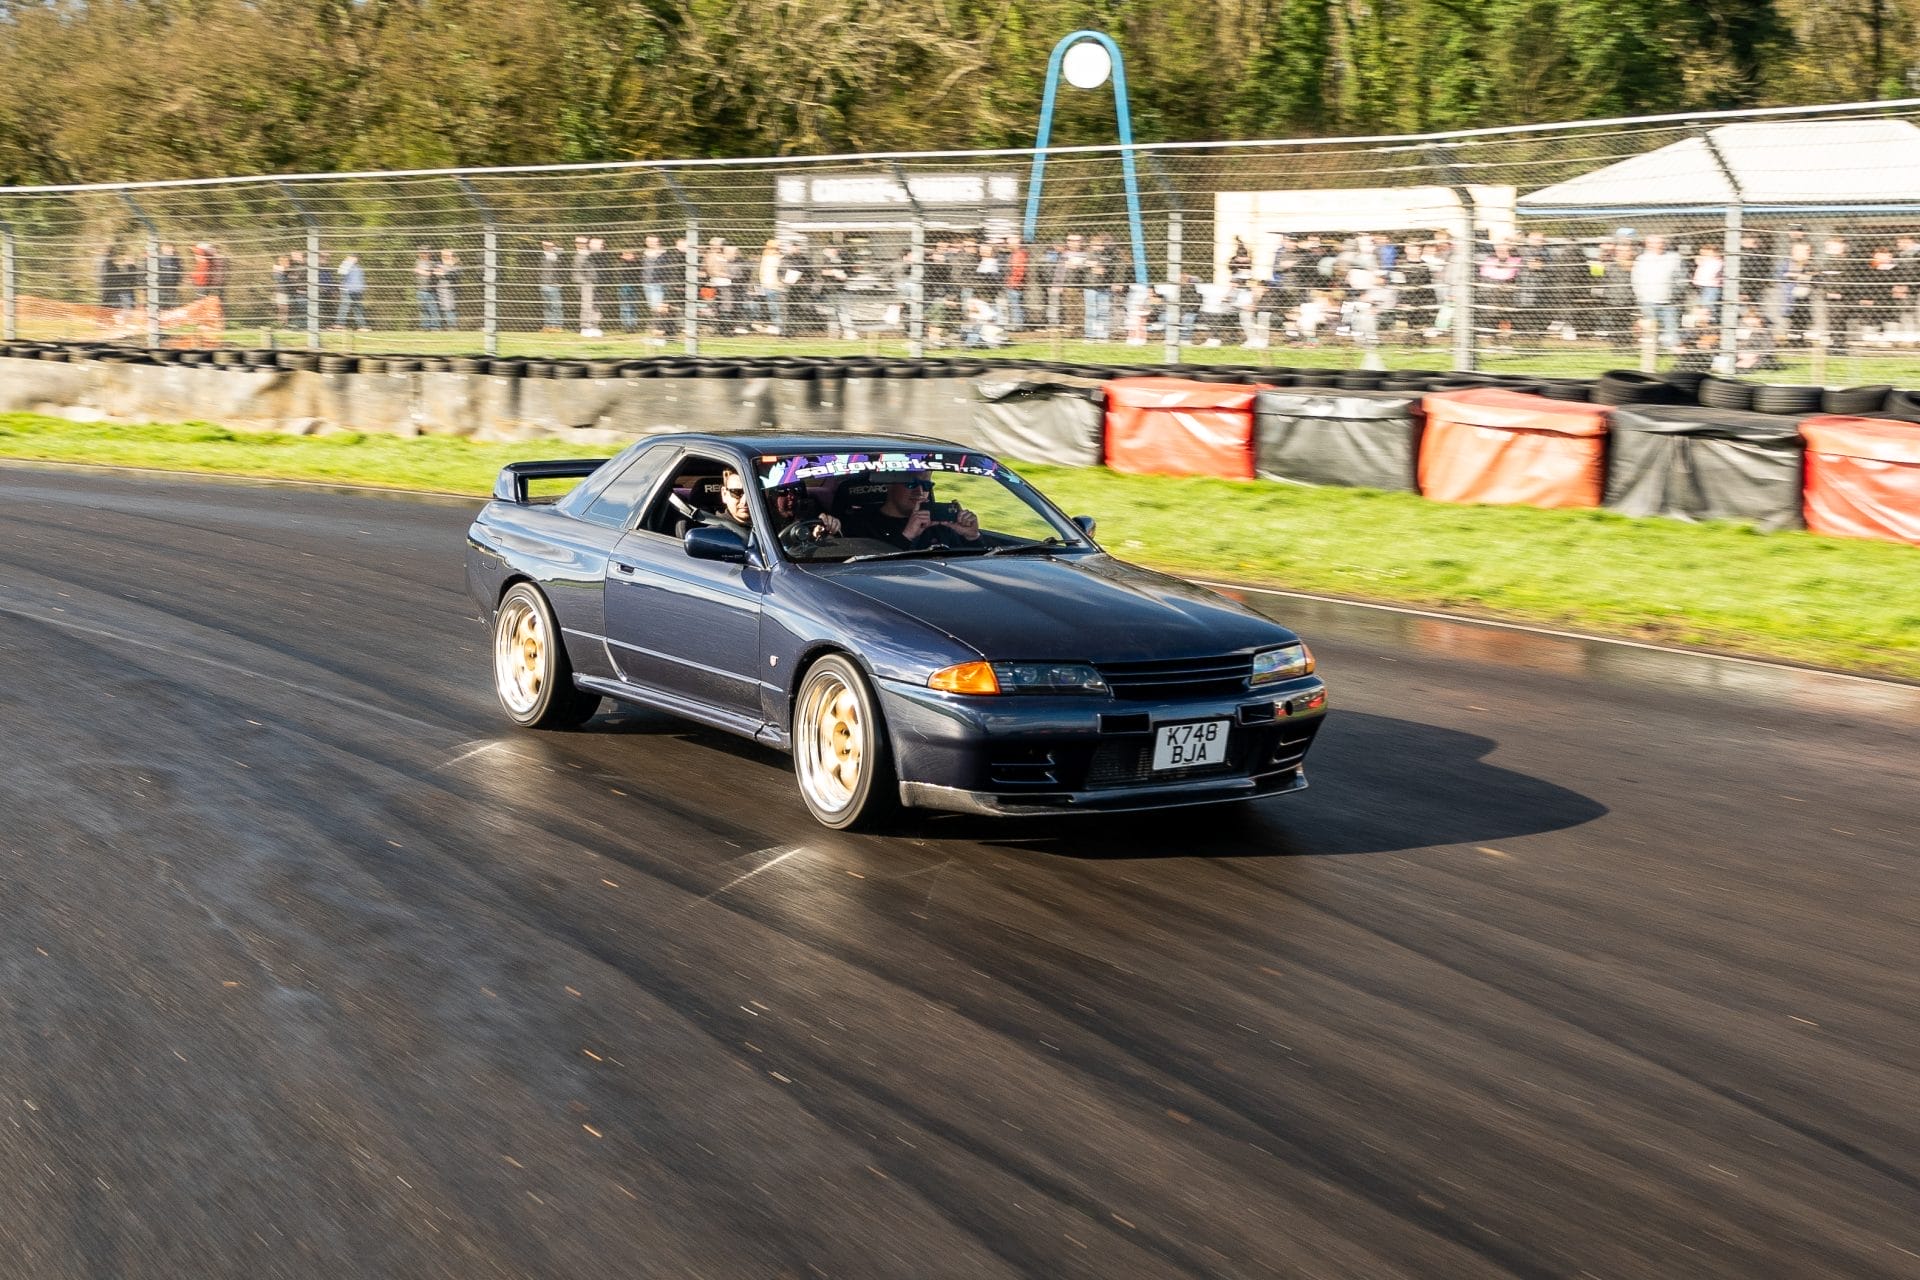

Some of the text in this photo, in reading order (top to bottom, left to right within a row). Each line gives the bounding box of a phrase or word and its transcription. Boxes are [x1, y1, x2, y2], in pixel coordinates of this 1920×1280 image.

[849, 484, 888, 495] RECARO
[1167, 723, 1218, 746] K748
[1171, 743, 1207, 764] BJA
